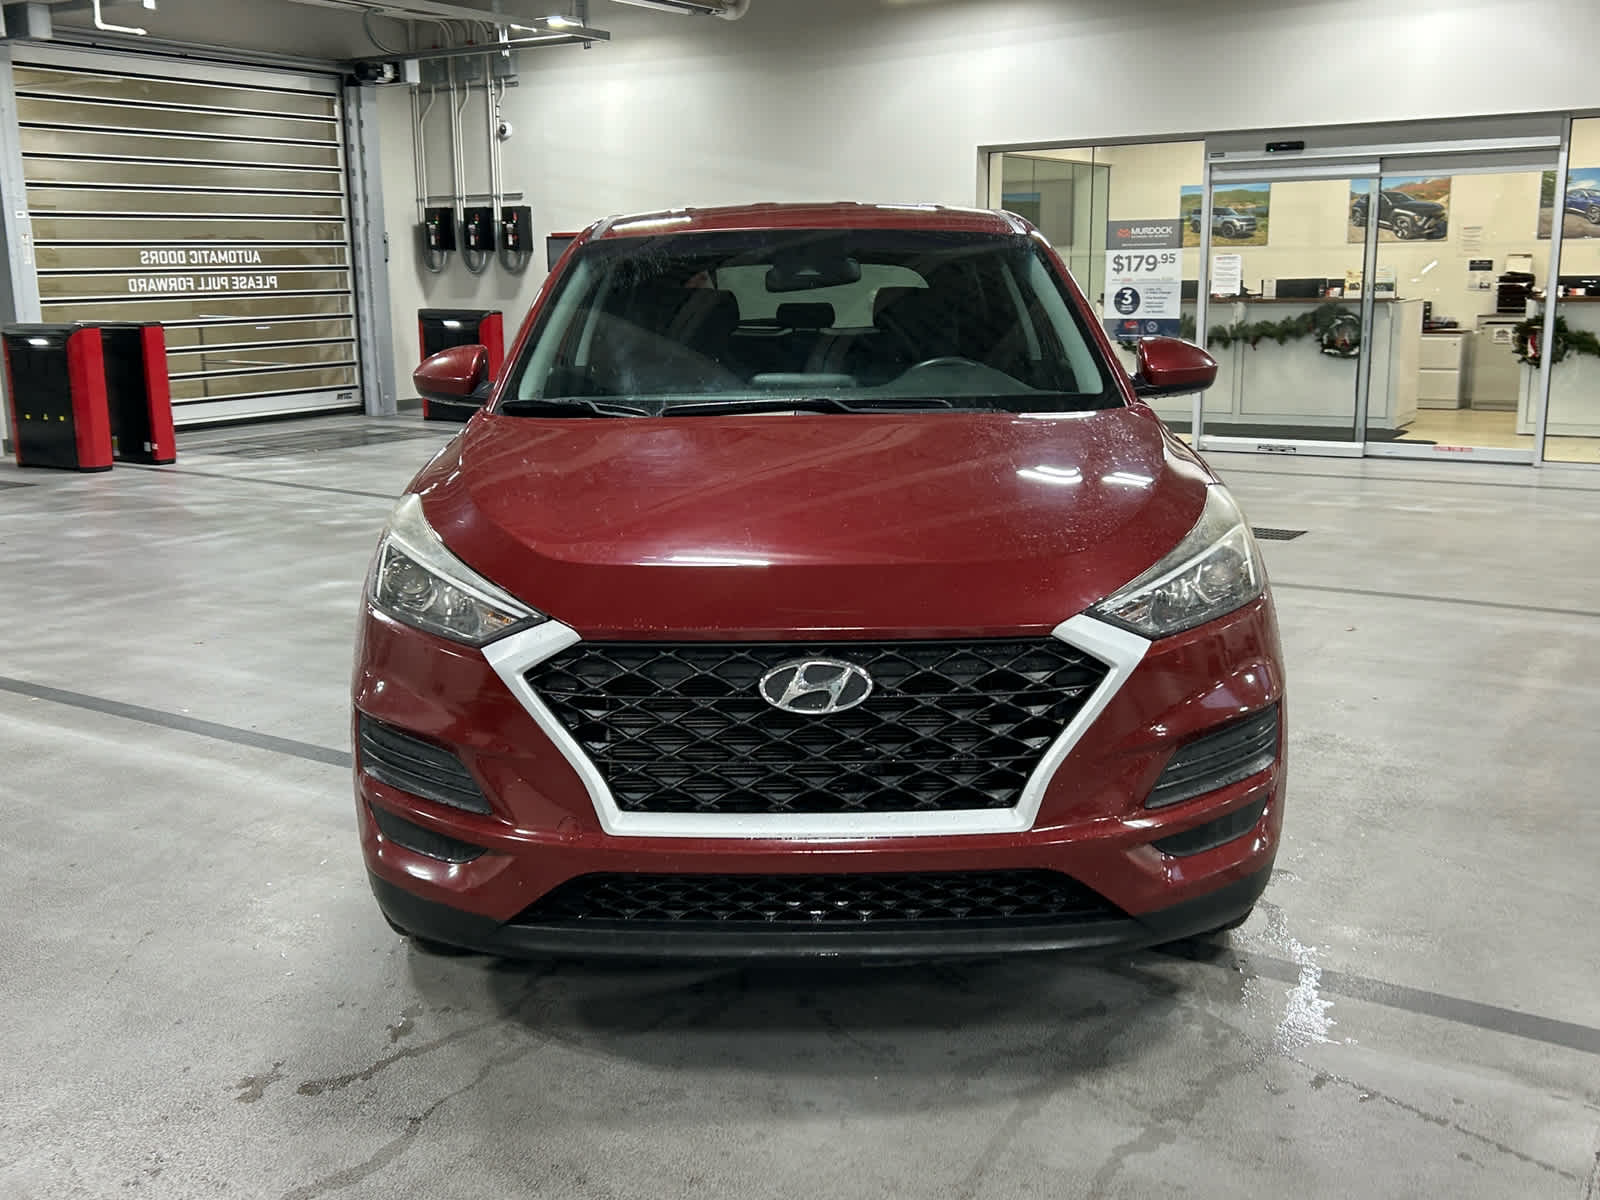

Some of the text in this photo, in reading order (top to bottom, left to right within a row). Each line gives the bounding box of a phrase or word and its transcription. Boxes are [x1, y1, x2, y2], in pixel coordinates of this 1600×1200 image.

[1131, 226, 1173, 235] MURDOCK
[1112, 253, 1176, 275] $179.95
[1121, 289, 1133, 305] 3
